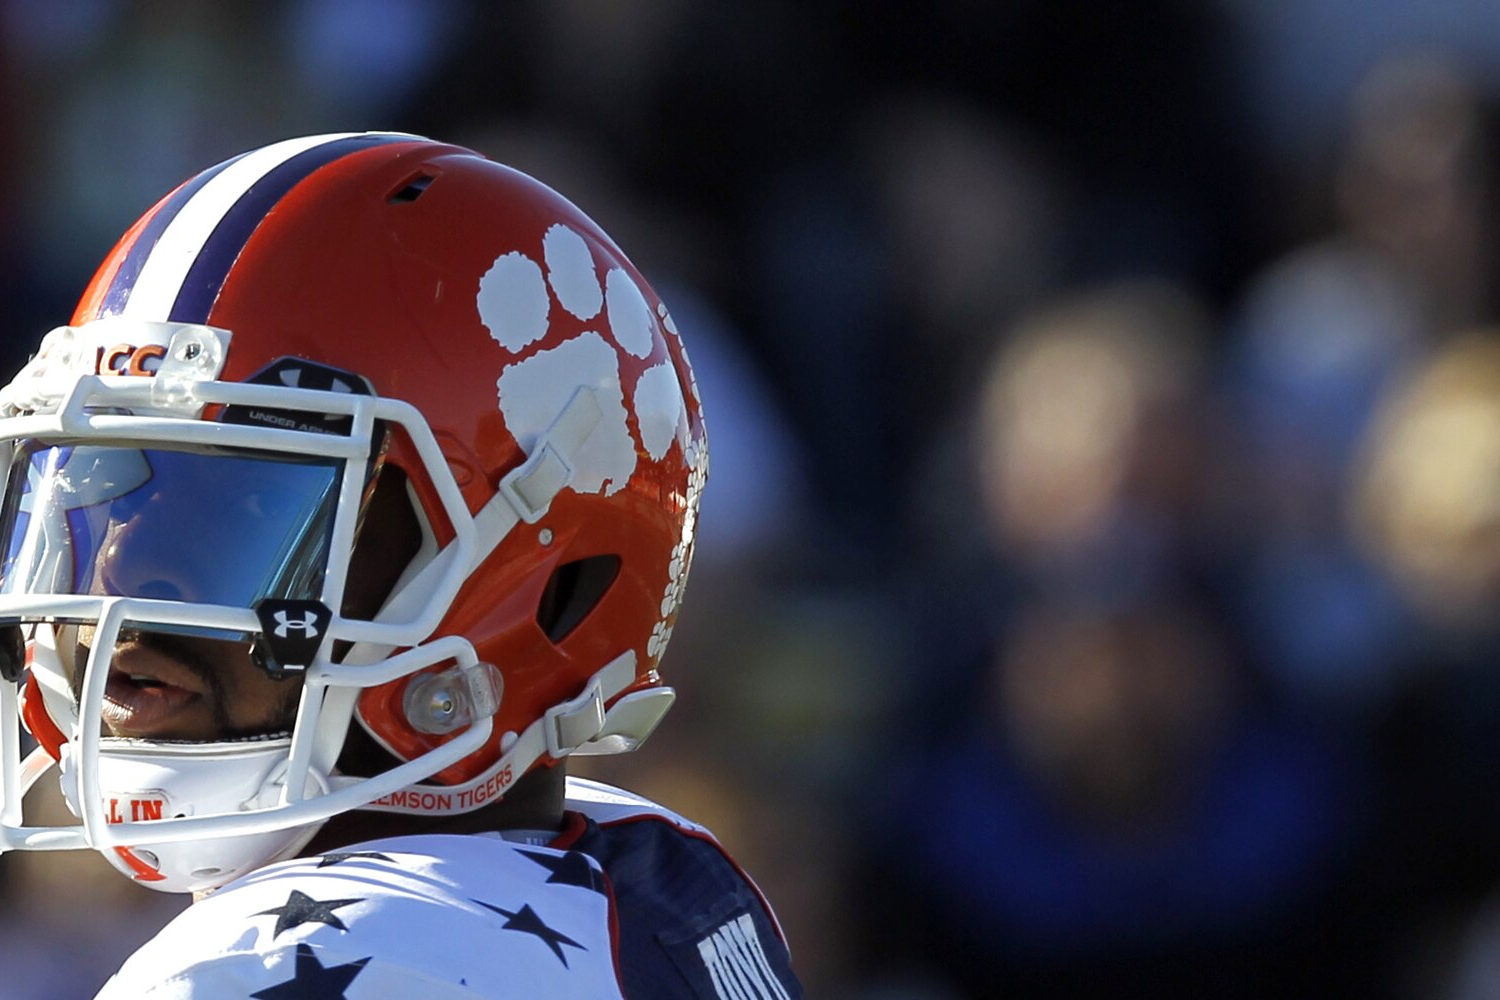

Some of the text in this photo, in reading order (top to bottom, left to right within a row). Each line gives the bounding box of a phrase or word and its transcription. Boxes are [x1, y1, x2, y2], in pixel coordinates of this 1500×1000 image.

[249, 410, 295, 428] UNDER
[457, 763, 513, 808] TIGERS
[130, 799, 163, 821] IN
